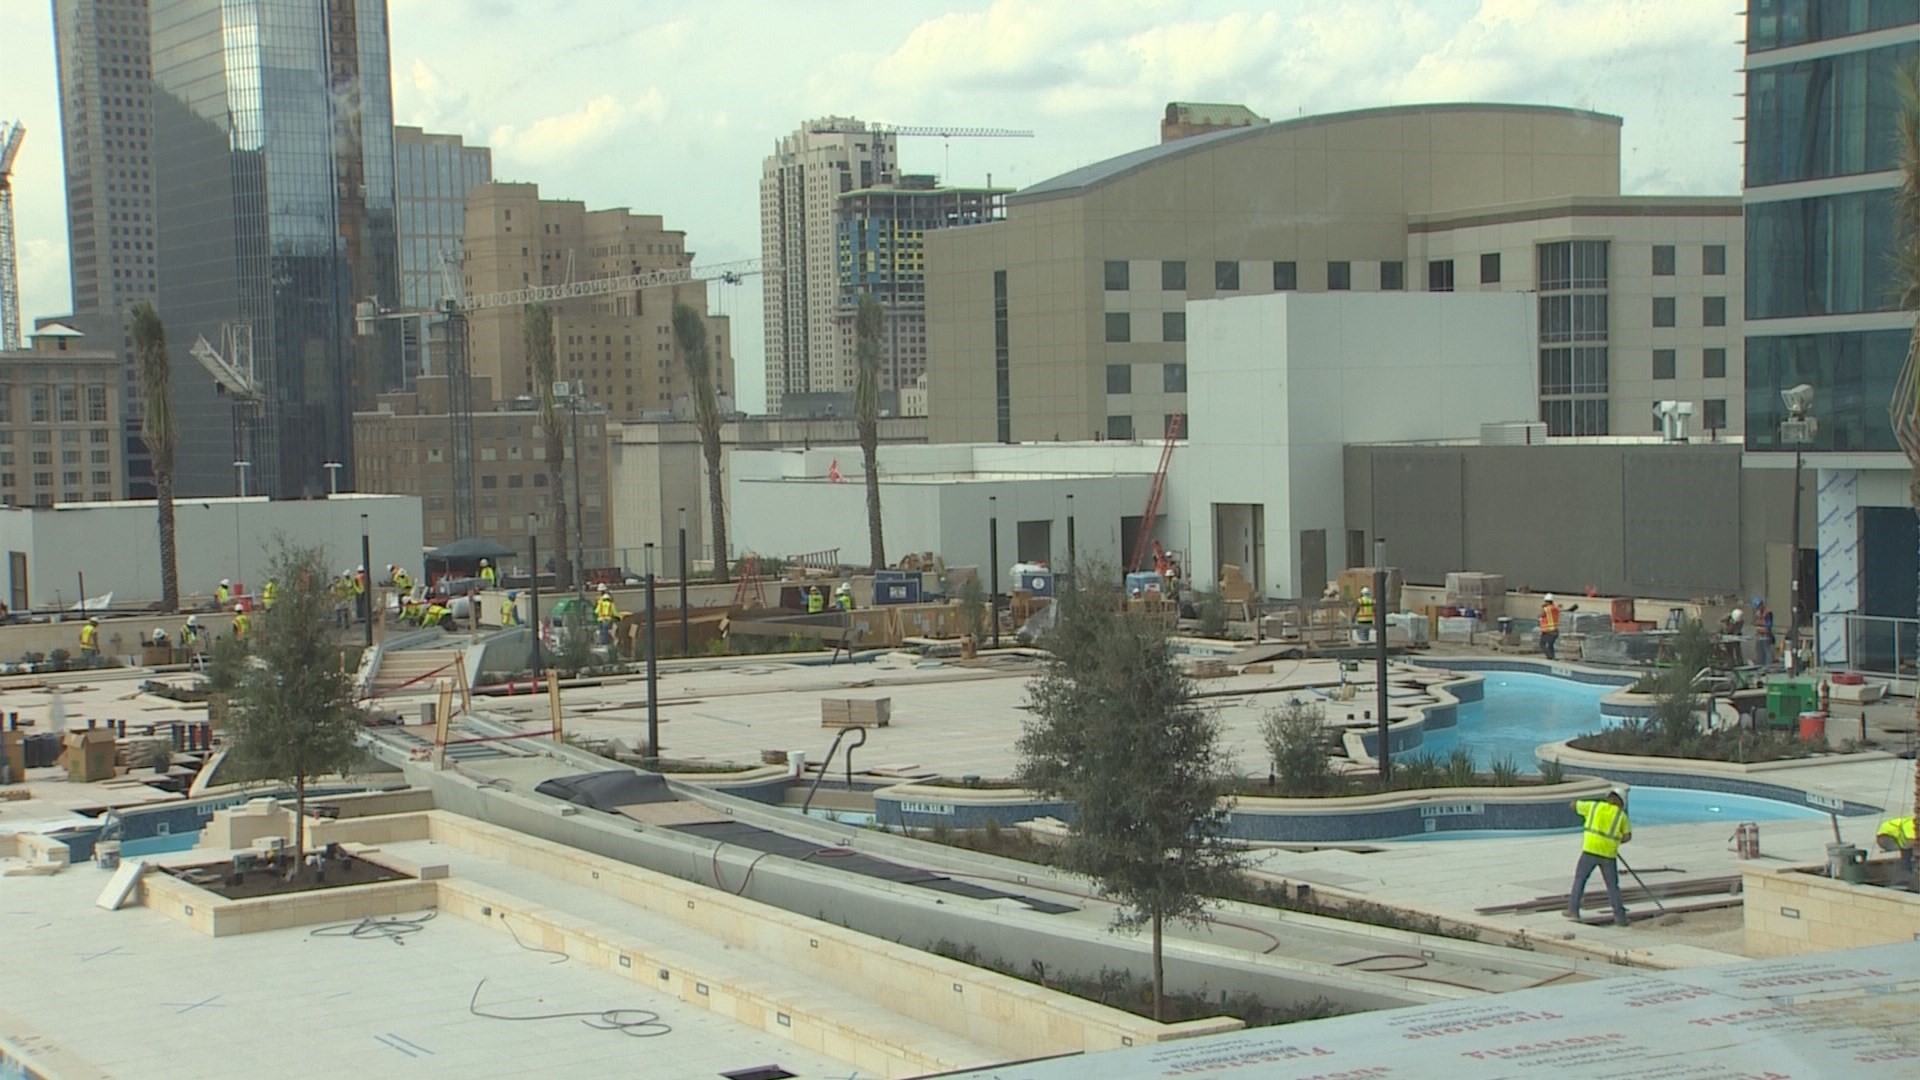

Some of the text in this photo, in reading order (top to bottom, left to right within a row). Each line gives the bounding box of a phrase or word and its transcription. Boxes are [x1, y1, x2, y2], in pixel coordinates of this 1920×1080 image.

[1402, 1011, 1564, 1040] Firestone
[1161, 1046, 1335, 1076] Firestone
[1461, 1033, 1627, 1060] Firestone
